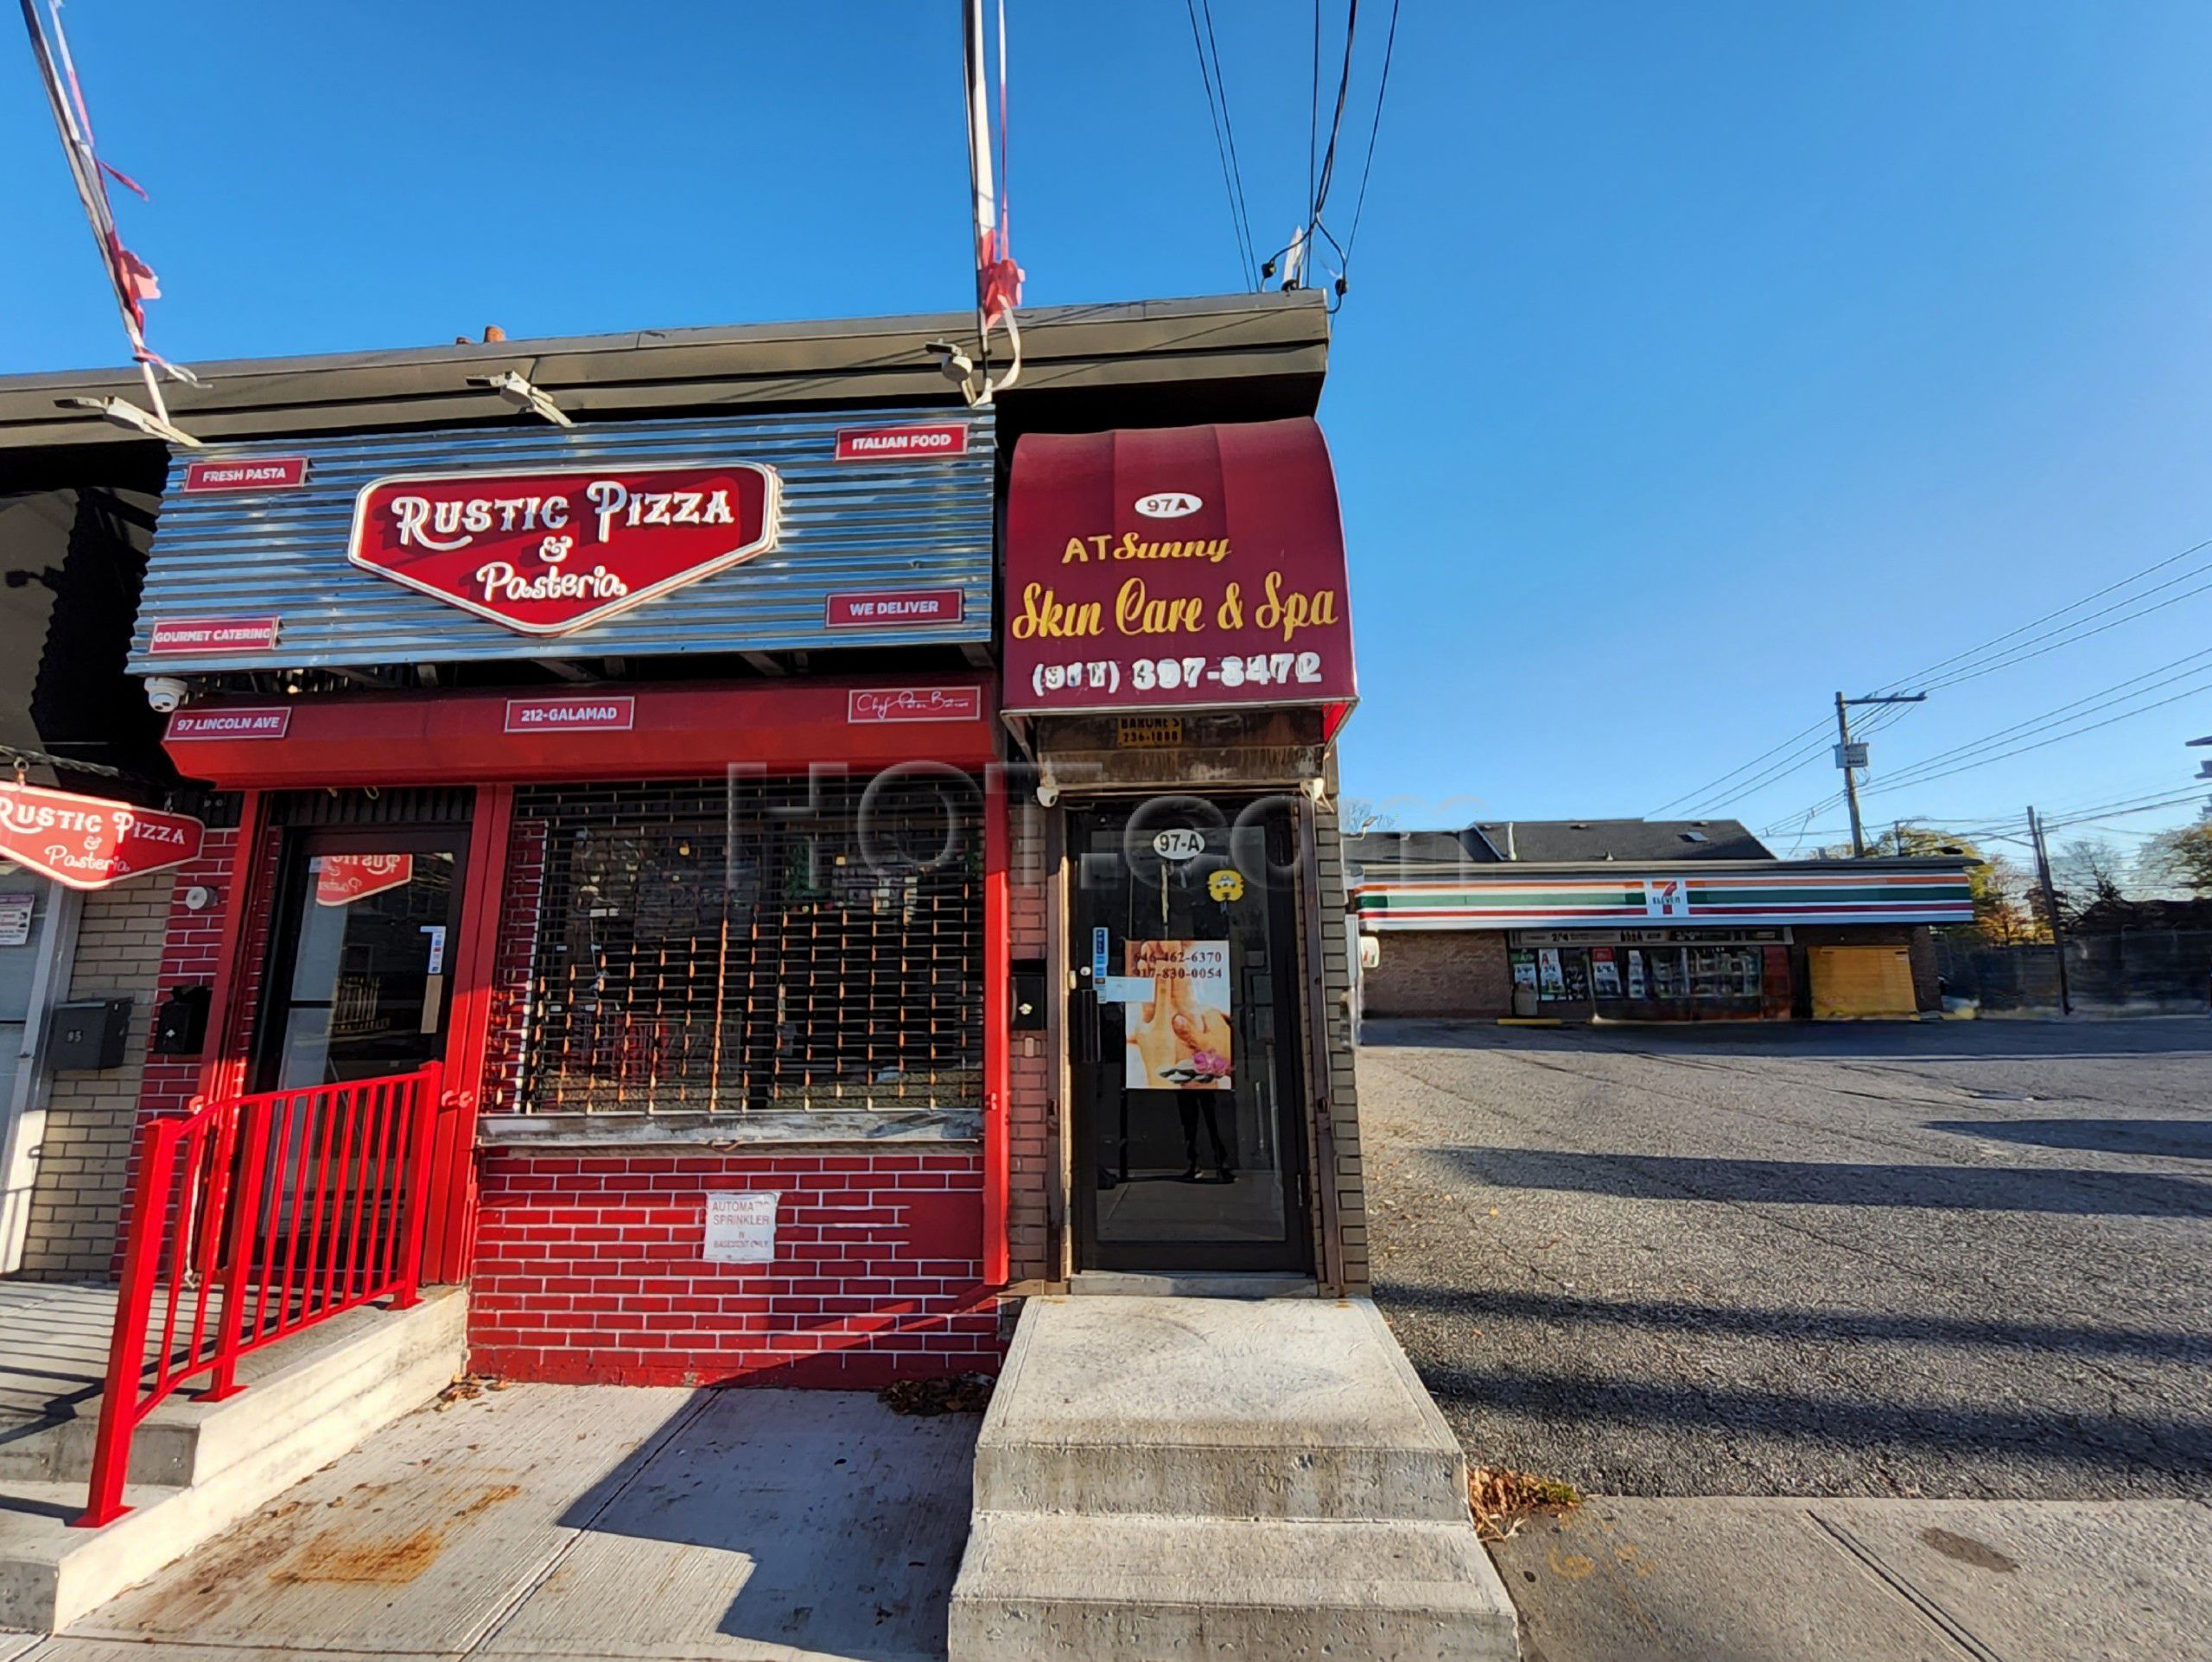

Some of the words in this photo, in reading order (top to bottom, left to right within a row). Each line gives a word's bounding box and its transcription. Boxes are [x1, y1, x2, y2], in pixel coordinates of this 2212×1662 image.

[851, 435, 908, 449] ITALIAN
[911, 434, 951, 447] FOOD
[202, 468, 244, 482] FRESH
[246, 467, 286, 481] PASTA
[1147, 498, 1190, 513] 97A
[538, 535, 574, 562] &
[1113, 532, 1232, 563] Sunny
[475, 561, 627, 602] Pasteria
[849, 602, 874, 615] WE
[876, 600, 938, 614] DELIVER
[1013, 583, 1104, 639] Skin
[1115, 577, 1205, 636] Care
[1217, 583, 1243, 631] &
[1255, 571, 1338, 642] Spa
[154, 629, 212, 644] GOURMET
[213, 627, 272, 641] CATERING
[521, 704, 617, 721] 212-GALAMAD
[857, 693, 892, 719] Chef
[176, 718, 193, 731] 97
[194, 716, 251, 730] LINCOLN
[252, 715, 280, 729] AVE
[84, 835, 102, 850] &
[1159, 833, 1200, 851] 97-A
[44, 844, 130, 872] Pasteria
[712, 1200, 769, 1212] AUTOMA
[713, 1214, 770, 1226] SPRINKLER
